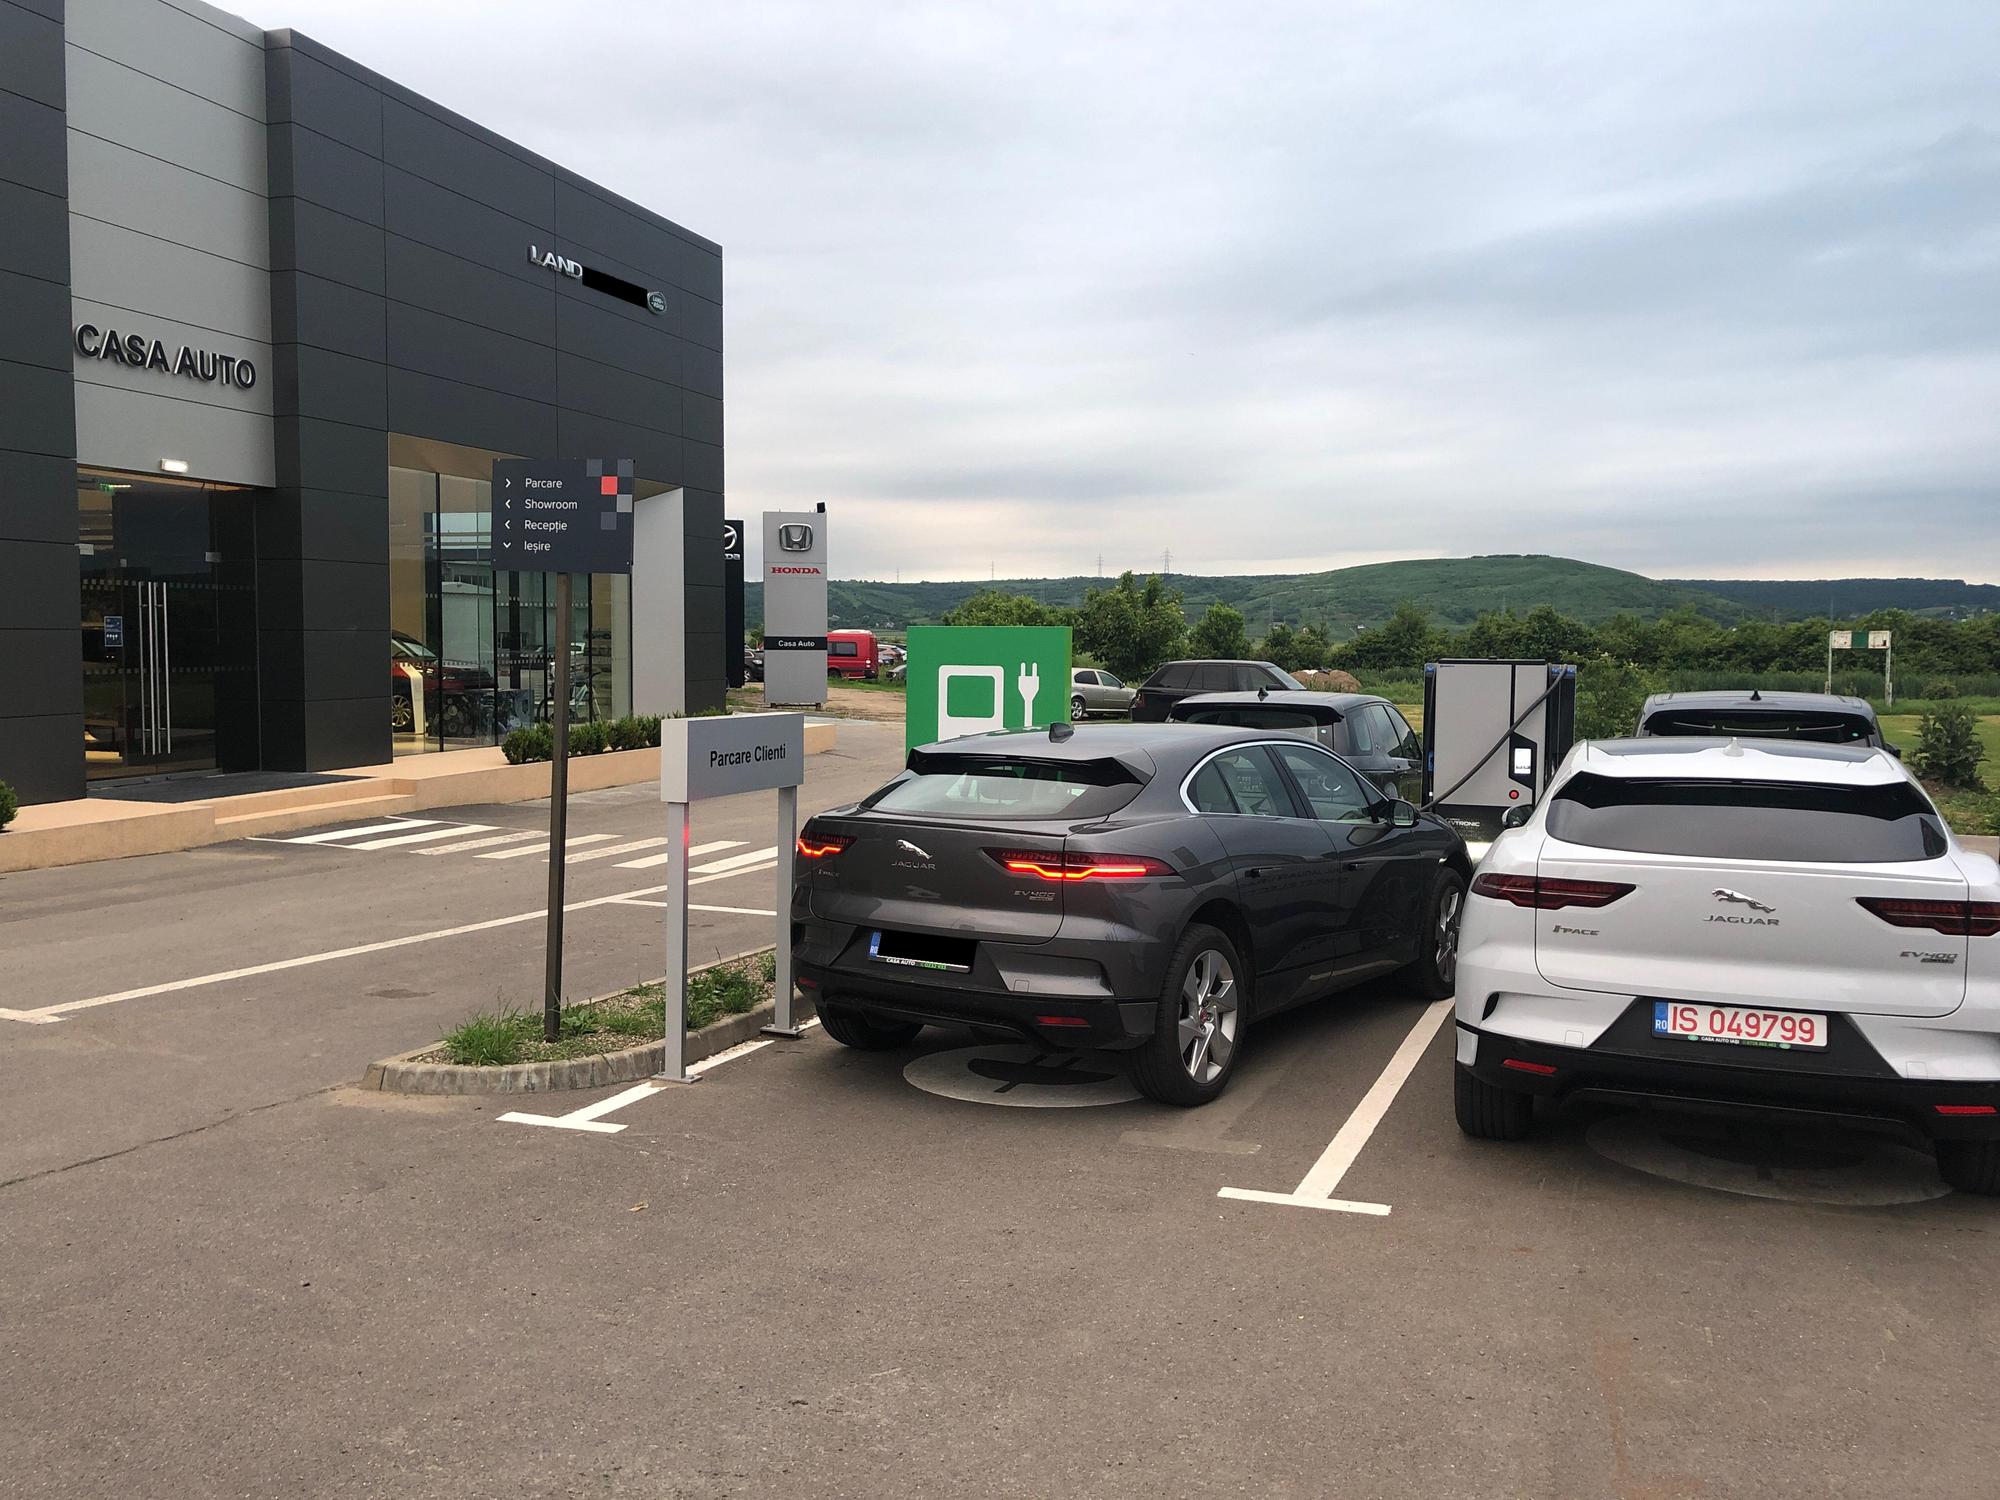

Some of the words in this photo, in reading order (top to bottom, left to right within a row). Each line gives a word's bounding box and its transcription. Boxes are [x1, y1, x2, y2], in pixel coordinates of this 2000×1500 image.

[528, 245, 582, 279] LAND
[76, 323, 170, 373] CASA
[174, 345, 256, 389] AUTO
[525, 477, 563, 489] Parcare
[524, 498, 578, 510] Showroom
[524, 519, 568, 533] Recepție
[524, 540, 551, 554] Ieșire
[771, 566, 821, 574] HONDA
[710, 750, 752, 768] Parcare
[754, 743, 786, 763] Clienti
[891, 861, 936, 870] JAGUAR
[1703, 914, 1780, 926] JAGUAR
[1900, 951, 1958, 959] EV400
[1655, 1019, 1668, 1030] RO
[1671, 1006, 1698, 1032] IS
[1709, 1009, 1815, 1043] 049799
